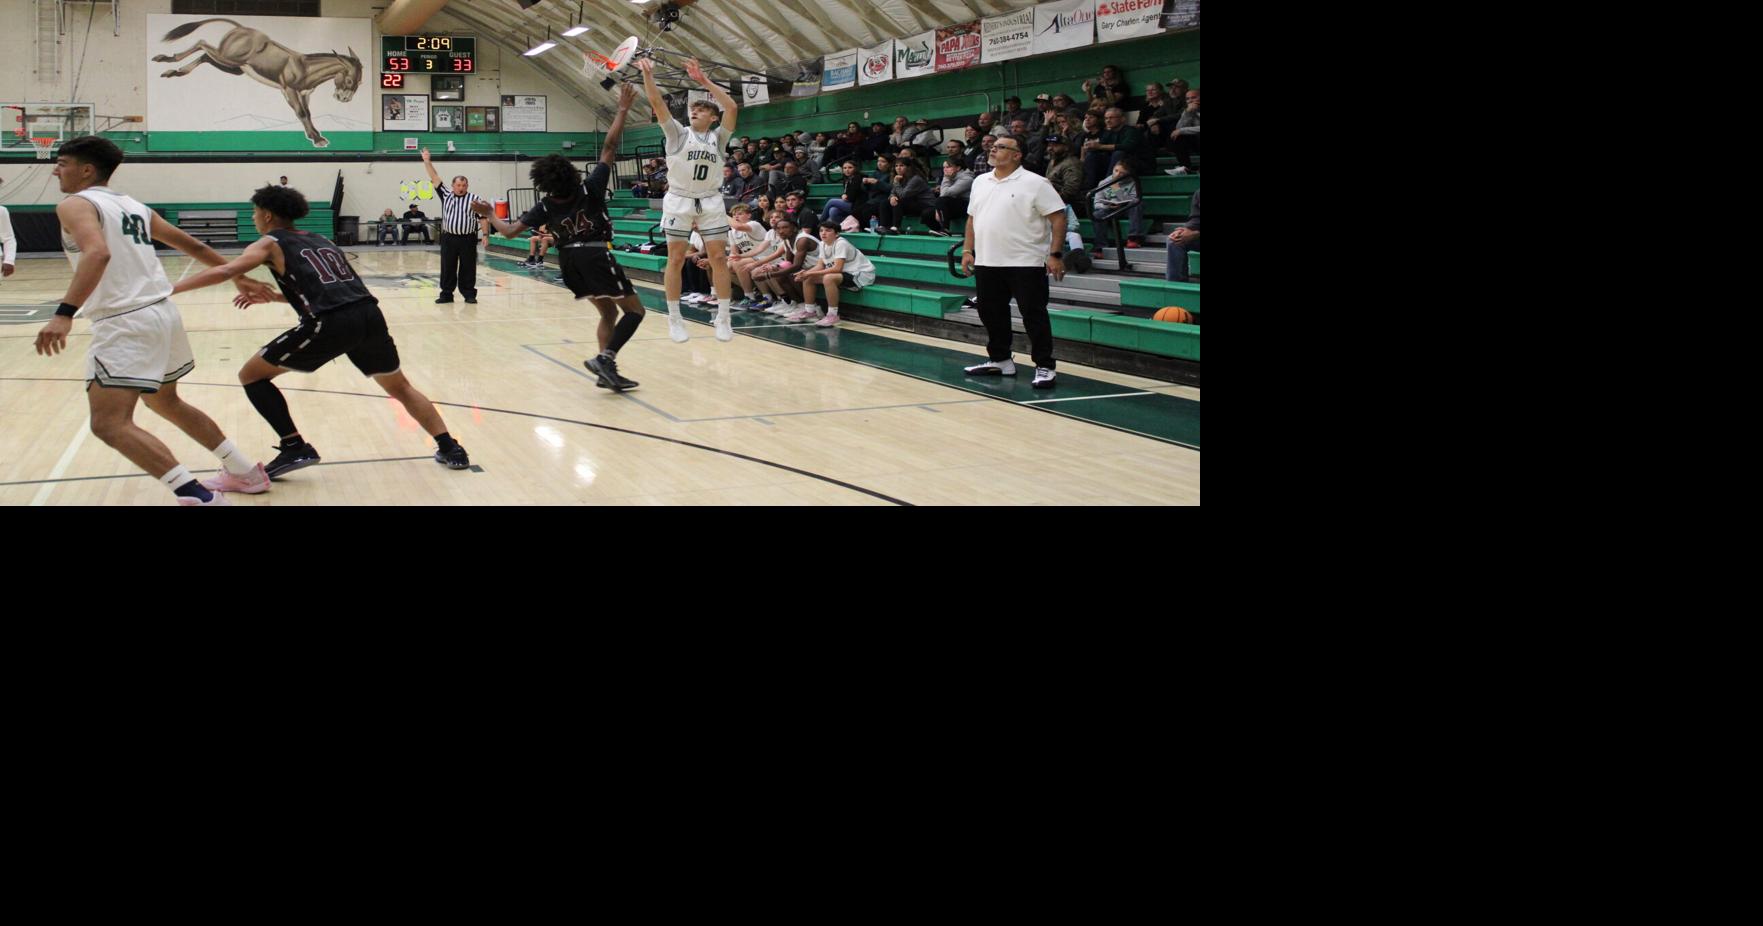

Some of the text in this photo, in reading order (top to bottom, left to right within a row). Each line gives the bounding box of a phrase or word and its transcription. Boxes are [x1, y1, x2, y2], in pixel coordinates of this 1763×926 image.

[1111, 1, 1136, 14] State
[417, 37, 450, 50] 2:09
[941, 37, 960, 53] PAPA
[389, 58, 409, 70] 53
[426, 59, 433, 70] 3
[453, 59, 472, 71] 33
[383, 74, 402, 87] 22
[693, 164, 709, 181] 10
[561, 209, 594, 238] 14
